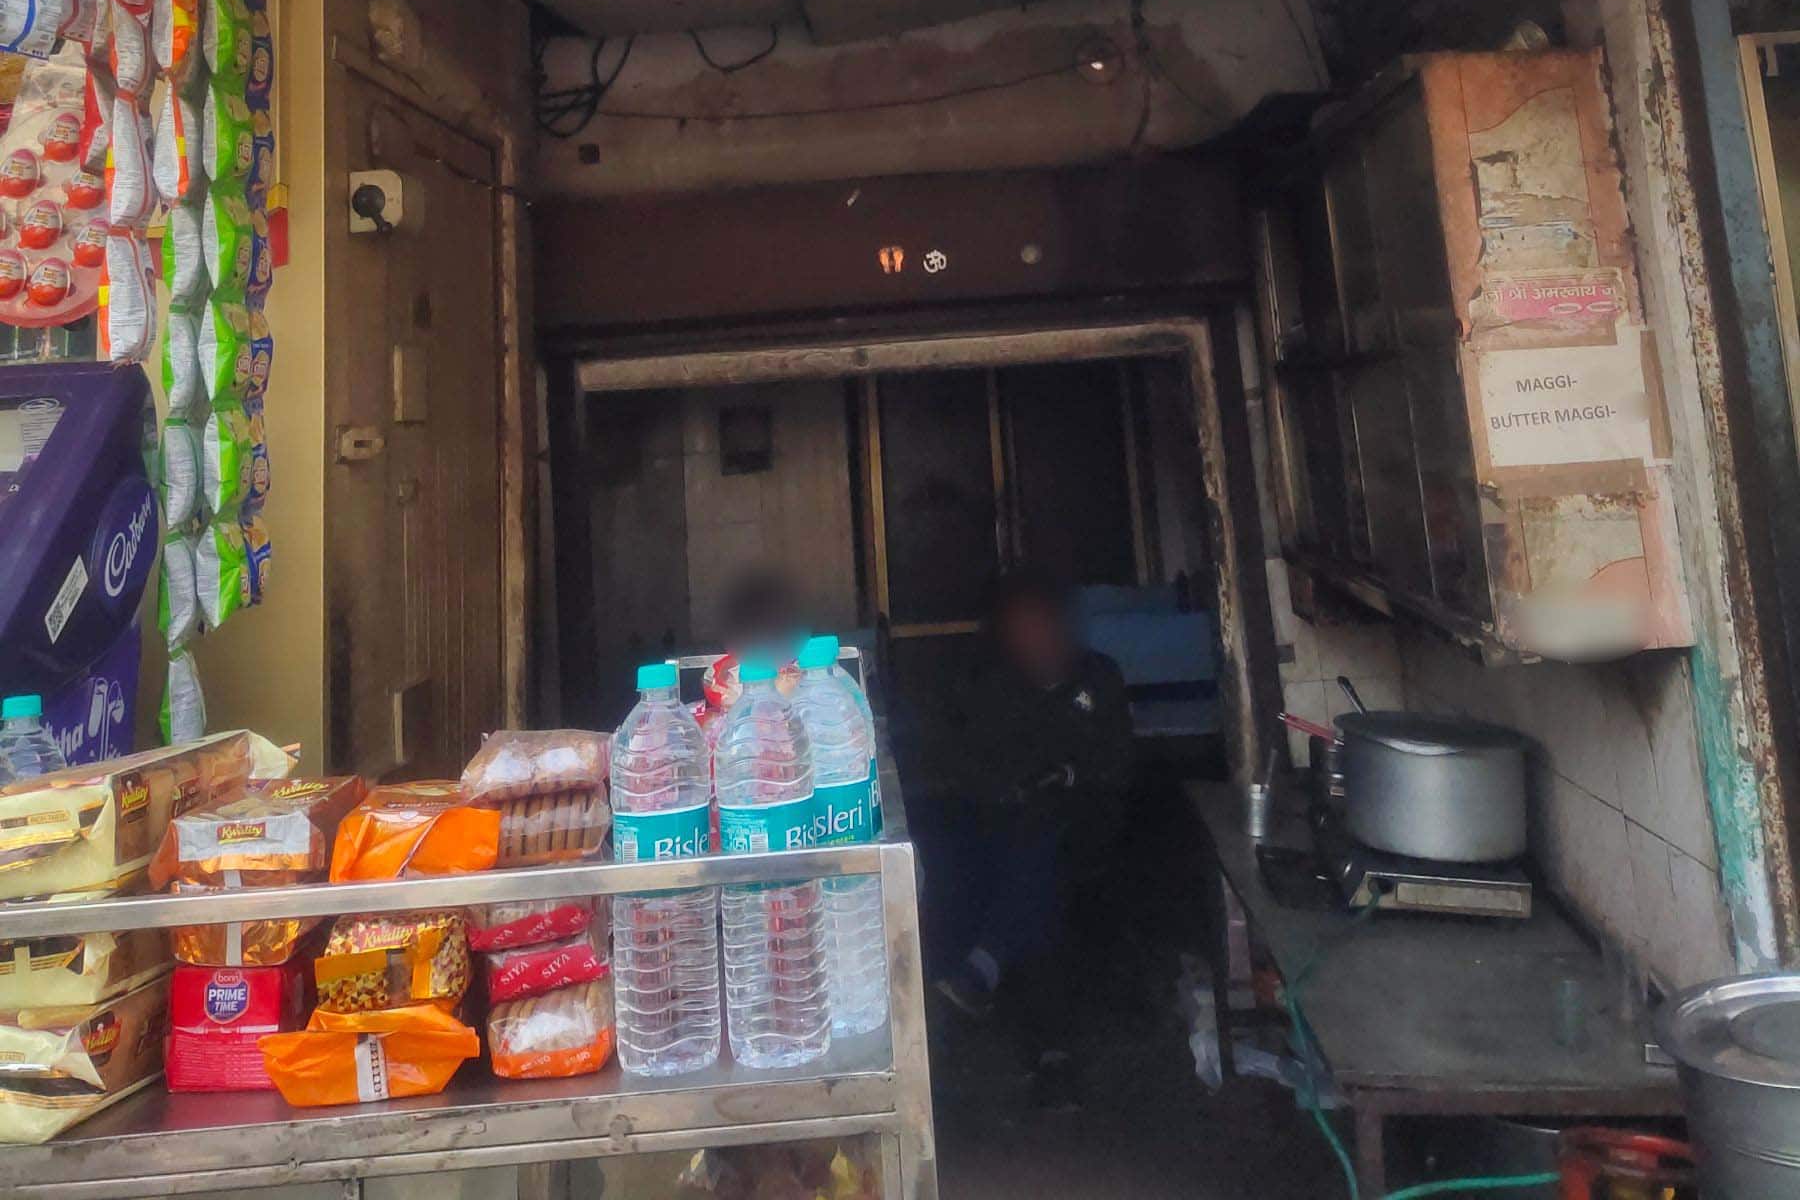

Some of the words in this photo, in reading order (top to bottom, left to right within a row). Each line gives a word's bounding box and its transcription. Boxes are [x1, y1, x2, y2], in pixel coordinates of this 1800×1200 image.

[1516, 374, 1577, 393] MAGGI-
[1490, 411, 1550, 430] BUTTER
[1554, 405, 1617, 423] MAGGI-
[364, 925, 414, 949] Kwality
[500, 959, 530, 985] SIYA
[541, 953, 571, 979] SIYA
[208, 988, 246, 1002] PRIME
[214, 1001, 239, 1012] TIME
